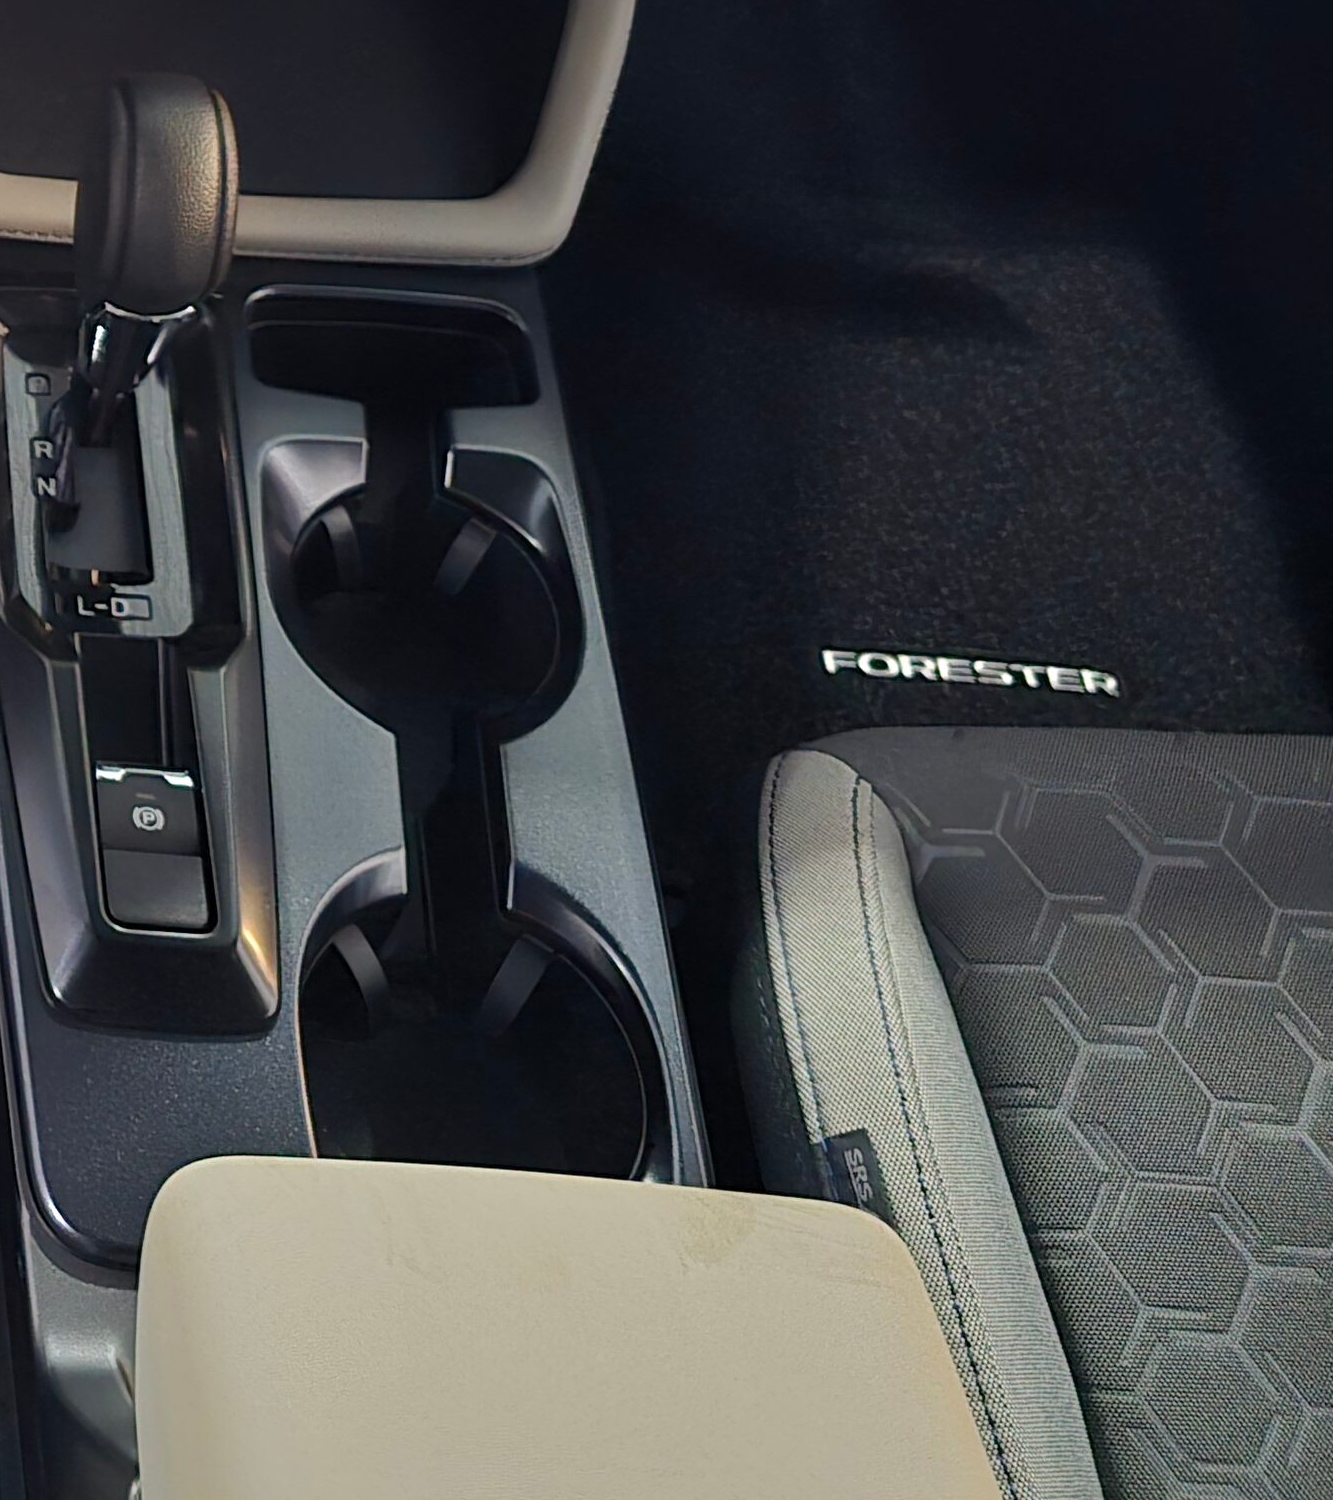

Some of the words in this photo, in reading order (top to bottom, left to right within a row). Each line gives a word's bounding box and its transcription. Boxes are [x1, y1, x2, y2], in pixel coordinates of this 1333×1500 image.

[34, 440, 53, 459] R
[37, 476, 56, 496] N
[821, 649, 1120, 698] FORESTER
[847, 1147, 874, 1202] SRS
